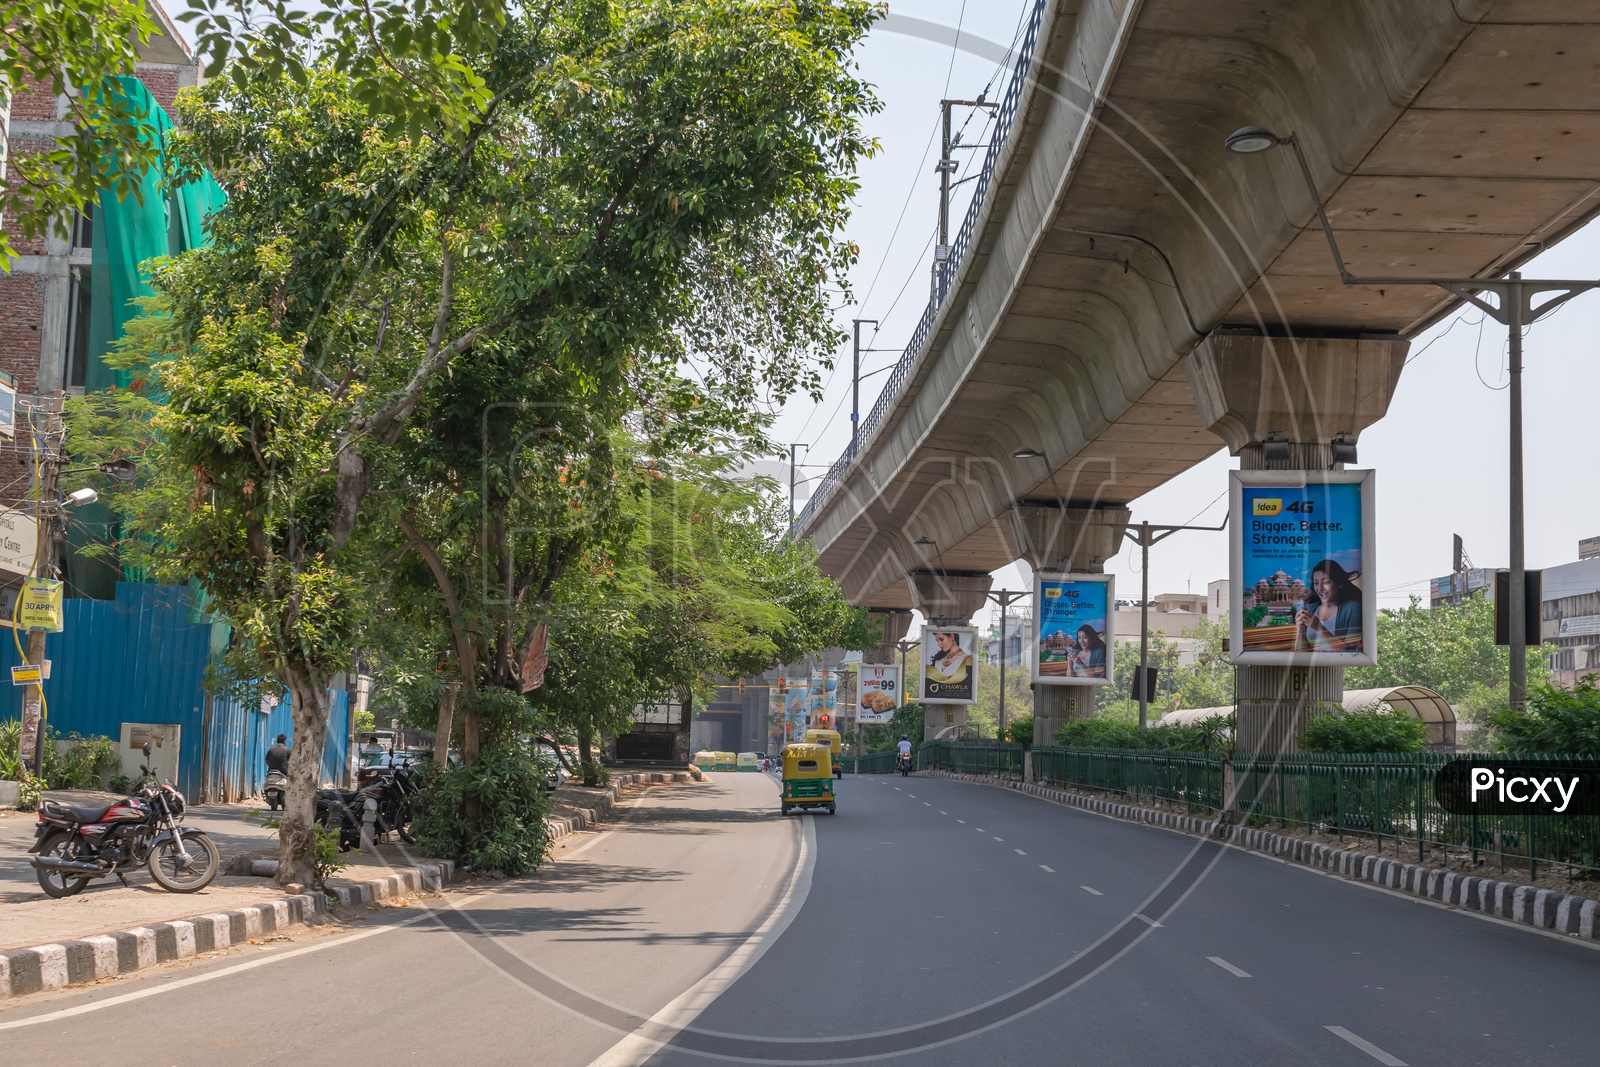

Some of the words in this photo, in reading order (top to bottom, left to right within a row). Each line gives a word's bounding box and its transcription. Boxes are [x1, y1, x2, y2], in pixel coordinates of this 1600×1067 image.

[1285, 501, 1315, 513] 4G
[1252, 520, 1295, 534] Bigger.
[1300, 520, 1343, 531] Better.
[1252, 533, 1311, 547] Stronger.
[1063, 590, 1080, 598] 4G
[24, 602, 35, 610] 30
[35, 604, 55, 612] APRIL
[1071, 601, 1095, 609] Better.
[1045, 608, 1078, 616] Stronger.
[881, 680, 895, 690] 99
